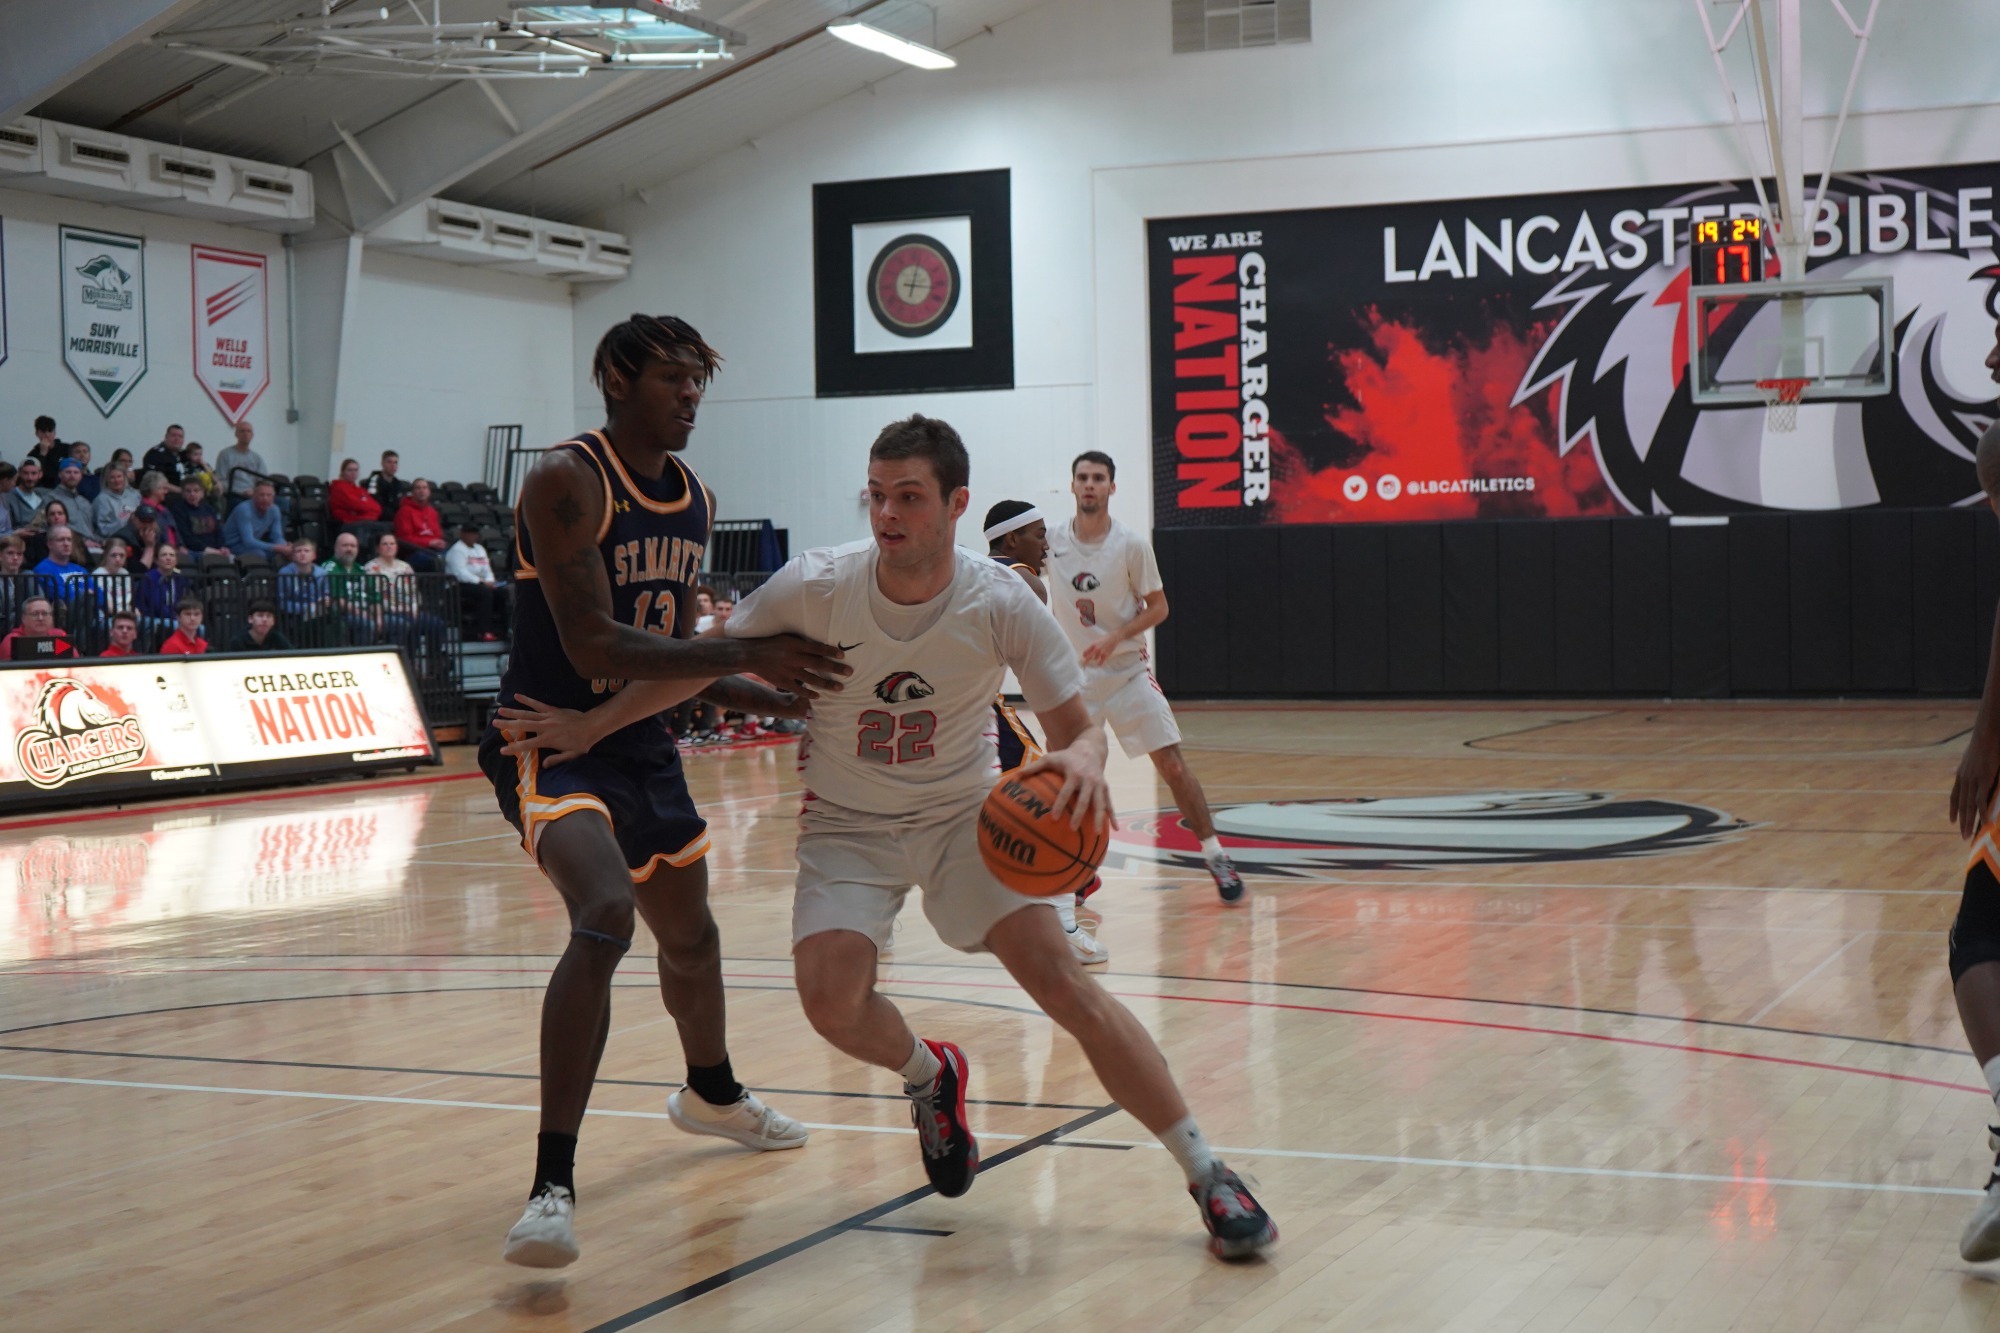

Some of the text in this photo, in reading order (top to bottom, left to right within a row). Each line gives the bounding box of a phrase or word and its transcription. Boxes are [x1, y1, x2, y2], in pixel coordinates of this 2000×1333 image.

[1169, 231, 1262, 252] WE ARE
[1384, 187, 1993, 283] LANCAST BIBLE
[1715, 244, 1750, 285] 17
[70, 337, 139, 358] MORRISVILLE
[90, 323, 120, 339] SUNY
[216, 337, 248, 353] WELLS
[212, 353, 252, 369] COLLEGE
[1172, 254, 1242, 509] NATION
[1238, 252, 1271, 507] CHARGER
[1406, 477, 1536, 496] @LBCATHLETICS
[633, 589, 676, 637] 13
[1075, 598, 1096, 627] 3
[244, 671, 359, 694] CHARGER
[249, 691, 376, 746] NATION
[21, 722, 142, 781] CHARGERS
[857, 709, 937, 765] 22
